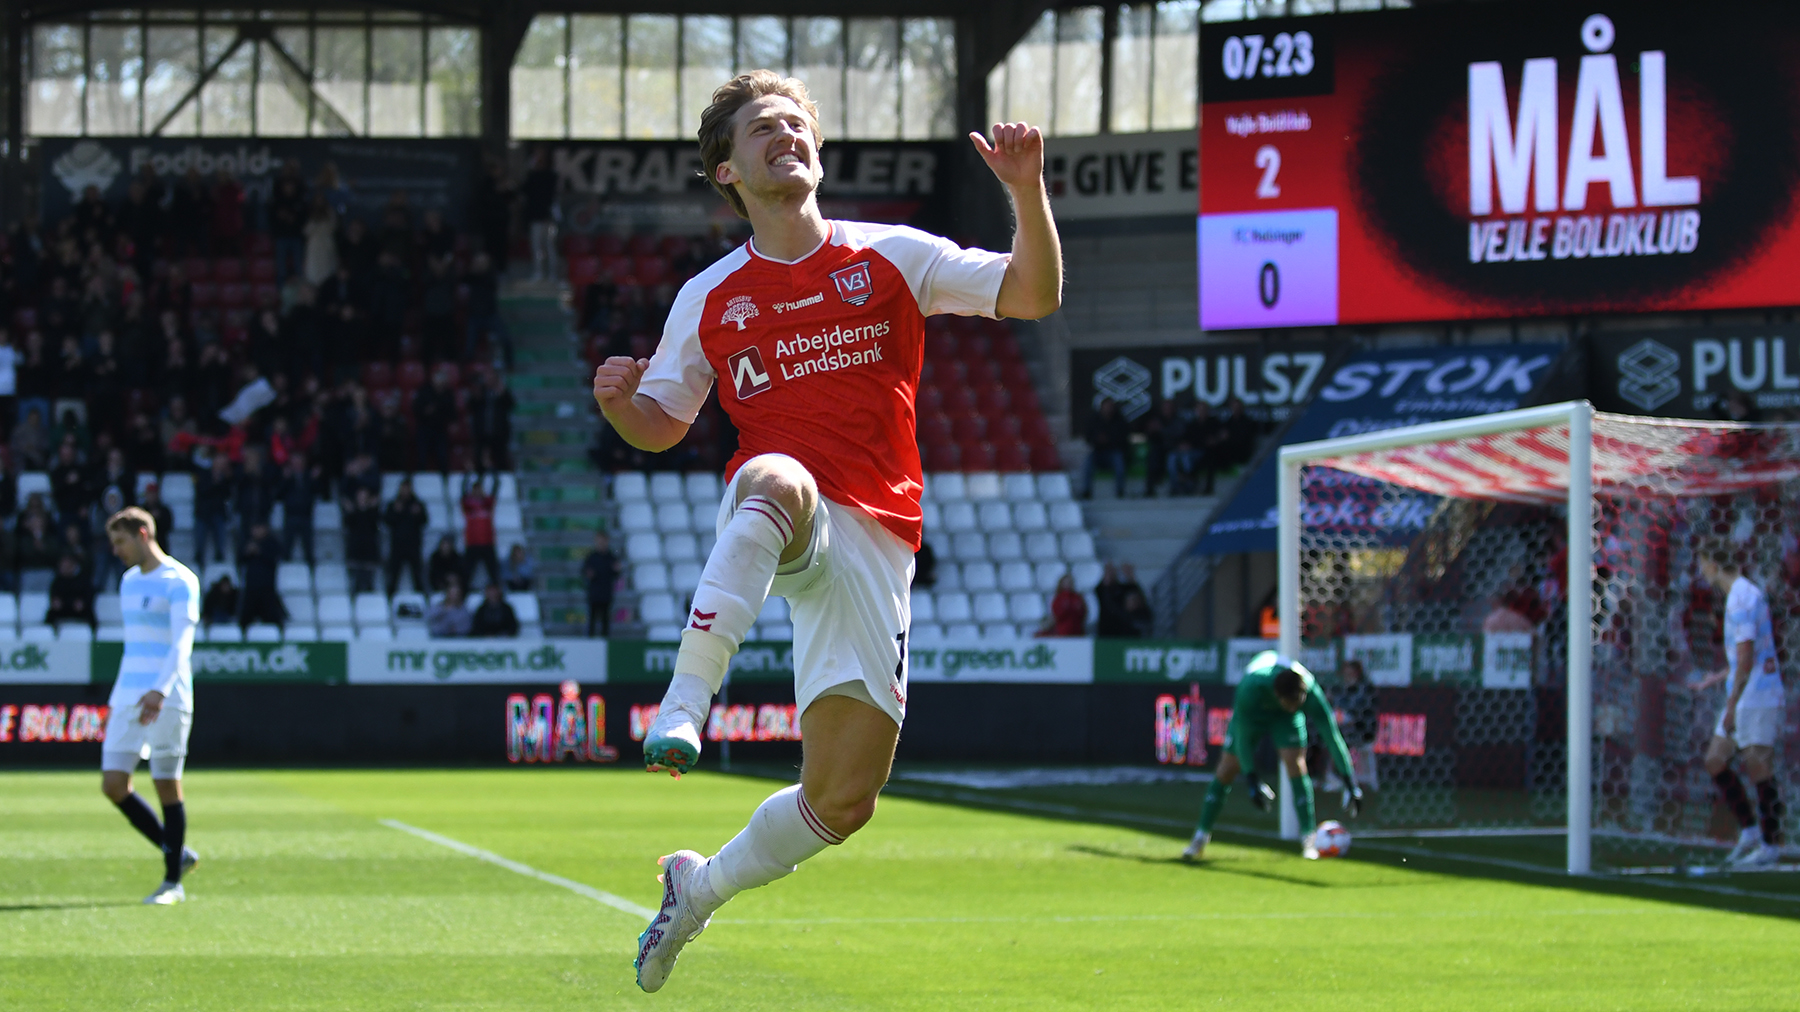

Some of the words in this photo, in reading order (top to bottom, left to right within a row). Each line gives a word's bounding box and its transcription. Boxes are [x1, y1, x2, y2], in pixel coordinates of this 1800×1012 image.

[1222, 30, 1315, 80] 07:23
[1467, 13, 1700, 215] MÅL
[1074, 151, 1165, 196] GIVE
[1254, 145, 1282, 199] 2
[1468, 217, 1550, 263] VEJLE
[1552, 209, 1701, 260] BOLDKLUB
[785, 291, 824, 312] hummel
[1258, 261, 1280, 309] 0
[775, 320, 890, 359] Arbejdernes
[780, 341, 883, 381] Landsbank
[1161, 352, 1326, 407] PULS7
[1320, 355, 1551, 402] STOK
[1693, 336, 1800, 392] PUL
[387, 650, 427, 670] mr
[432, 645, 566, 679] green.dk
[940, 644, 1057, 679] green.dk
[505, 679, 620, 764] MÅL
